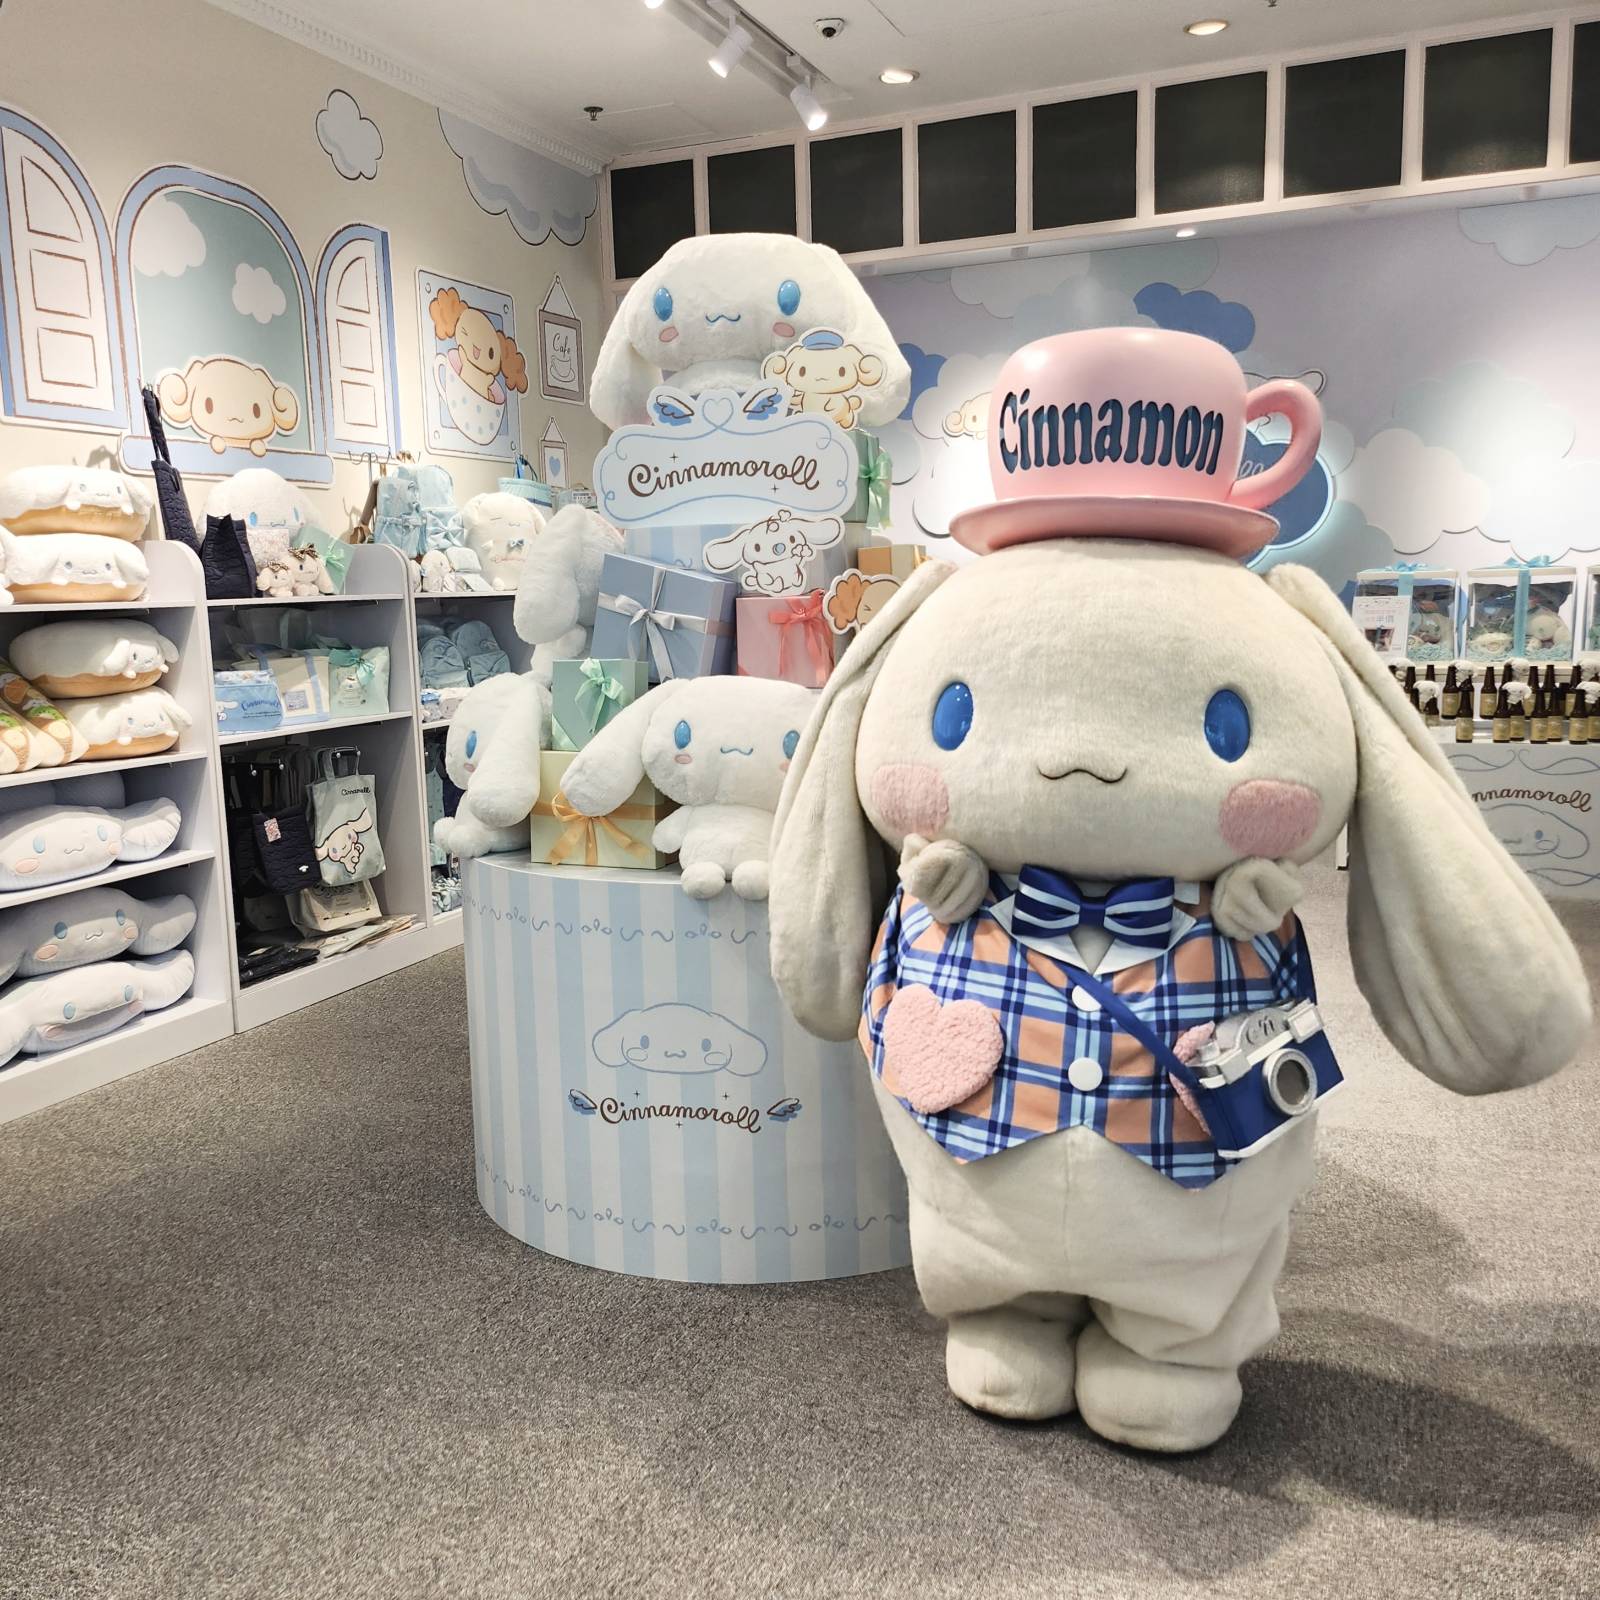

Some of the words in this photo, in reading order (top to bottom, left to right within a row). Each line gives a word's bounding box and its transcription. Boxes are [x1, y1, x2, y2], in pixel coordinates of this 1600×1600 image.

[1000, 388, 1224, 475] Cinnamon
[628, 454, 820, 498] Cinnamoroll
[1472, 788, 1592, 813] nnamoroll
[599, 1097, 762, 1134] Cinnamoroll
